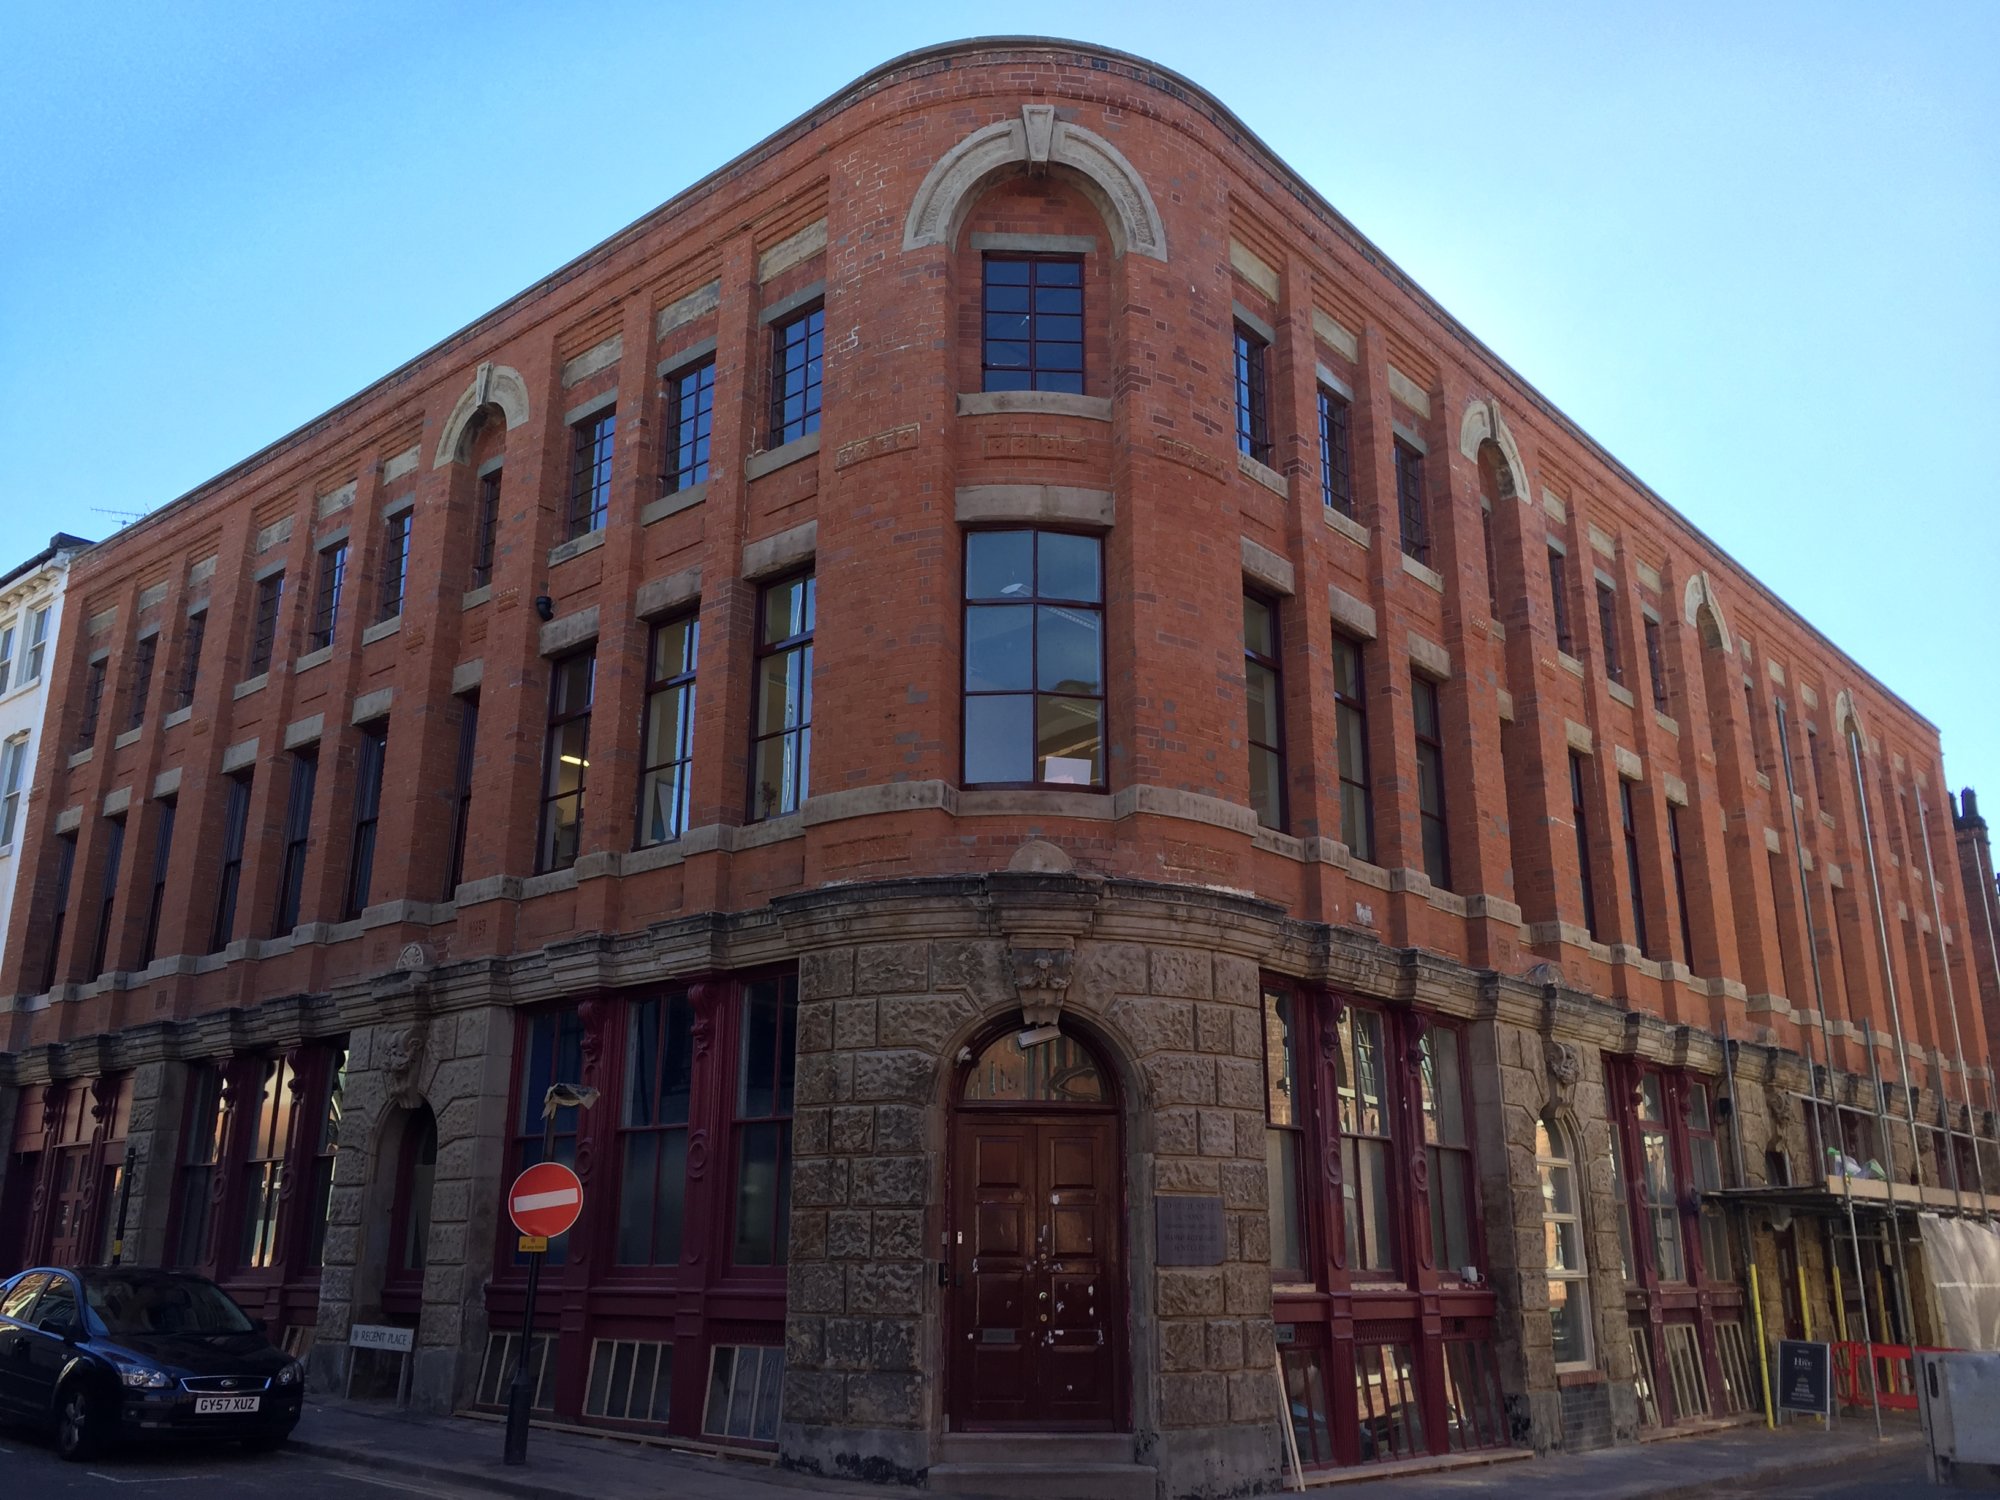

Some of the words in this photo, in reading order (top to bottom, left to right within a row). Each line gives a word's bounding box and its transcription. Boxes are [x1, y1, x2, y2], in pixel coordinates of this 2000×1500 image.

[361, 1330, 387, 1343] REGENT
[387, 1332, 408, 1346] PLACE
[201, 1399, 231, 1411] GY57
[233, 1398, 255, 1410] XUZ
